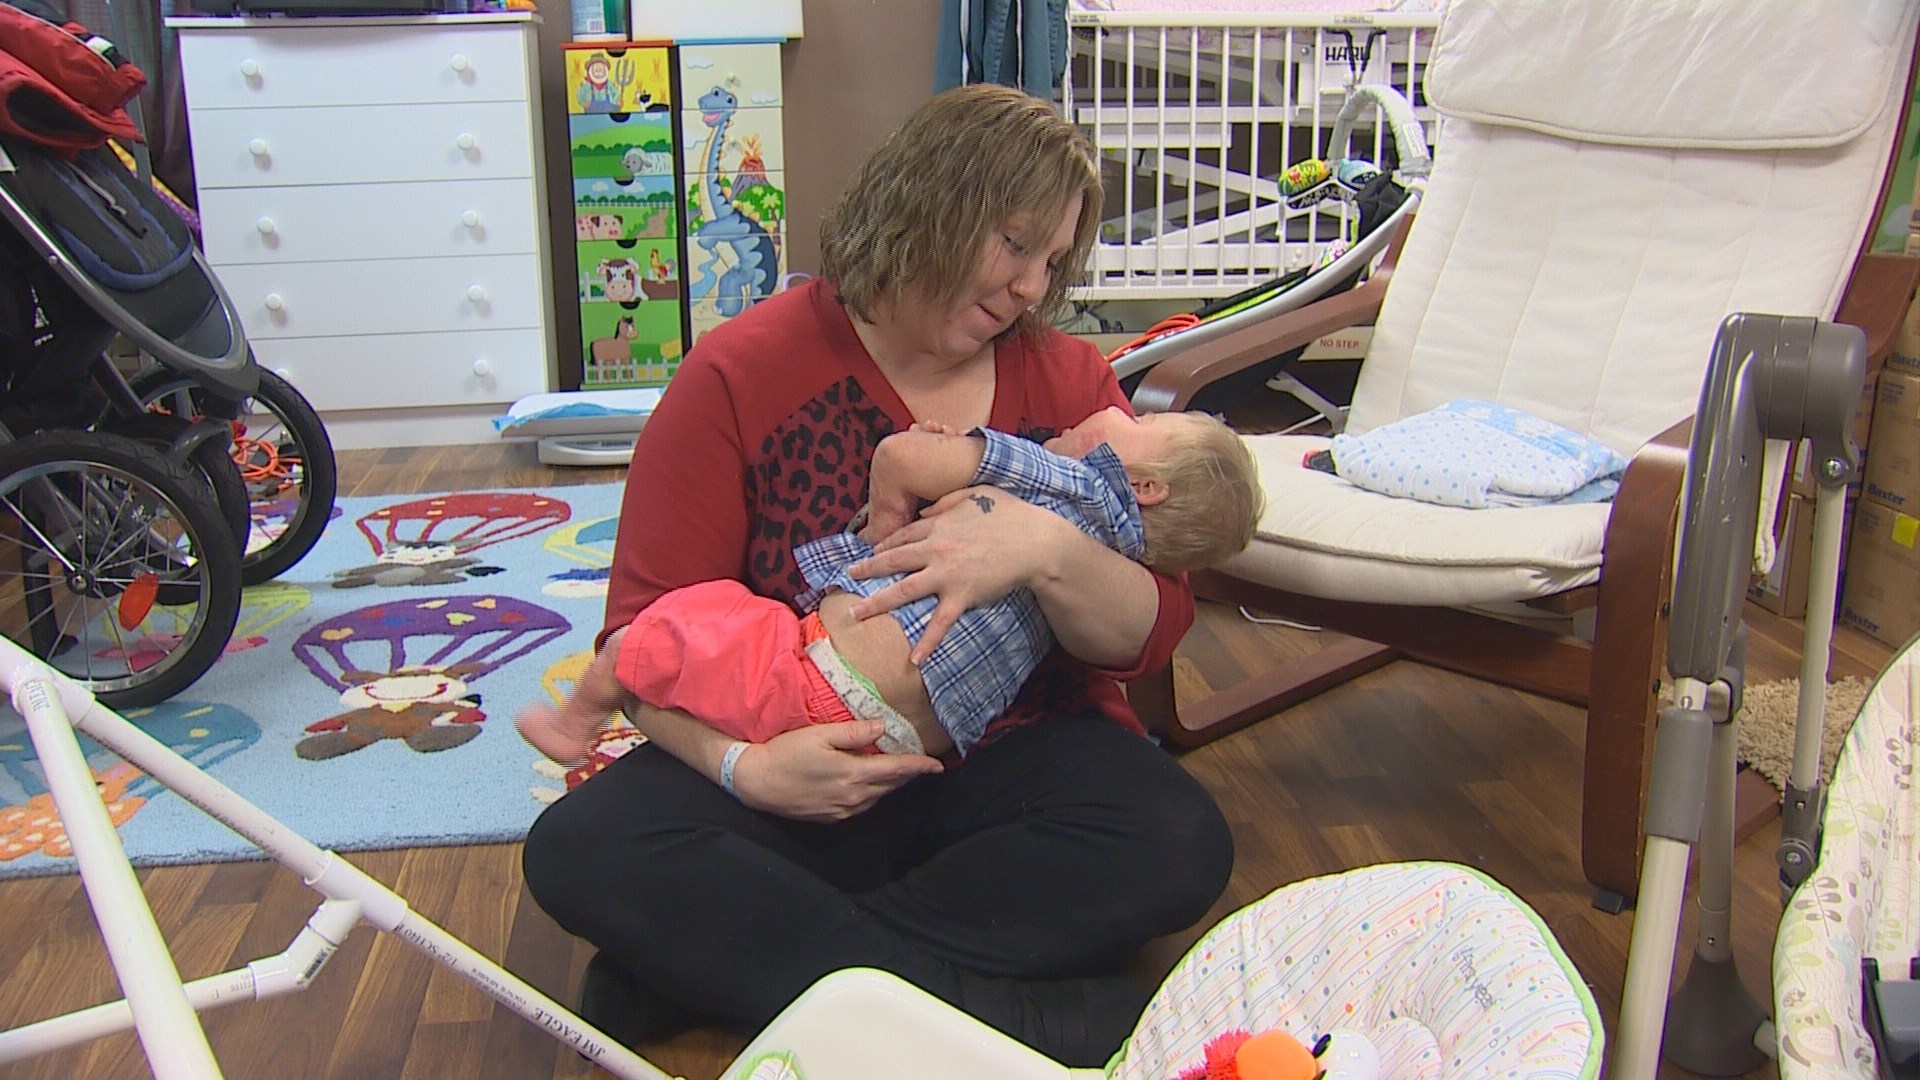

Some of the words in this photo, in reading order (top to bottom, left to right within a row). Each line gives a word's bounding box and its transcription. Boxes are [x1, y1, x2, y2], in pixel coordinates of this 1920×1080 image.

[1320, 339, 1334, 348] NO
[1336, 340, 1359, 349] STEP
[1868, 483, 1906, 506] Baxter
[1845, 606, 1881, 632] Baxter
[534, 1007, 582, 1045] EAGLE
[582, 1039, 606, 1058] JM
